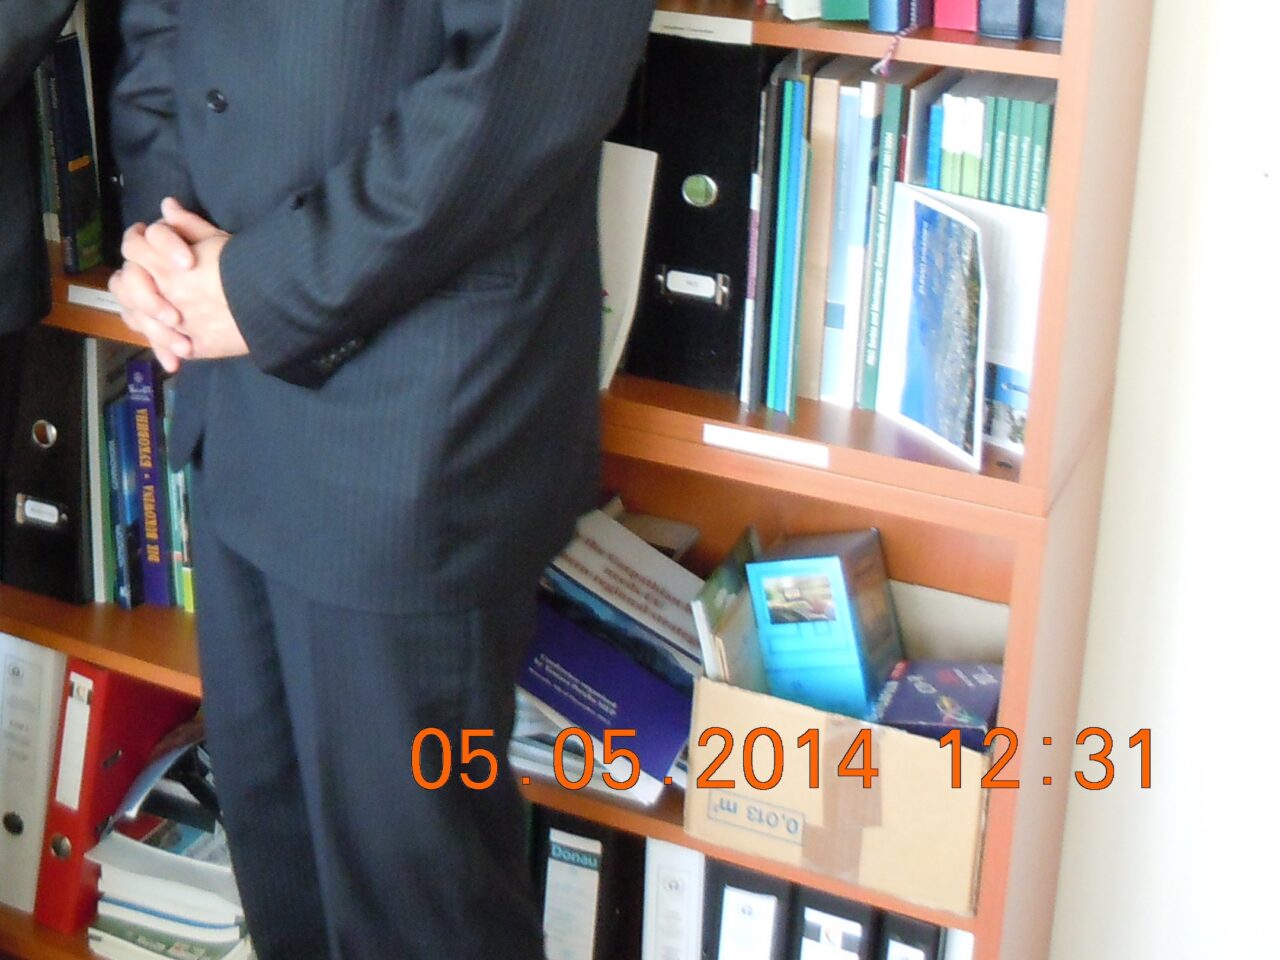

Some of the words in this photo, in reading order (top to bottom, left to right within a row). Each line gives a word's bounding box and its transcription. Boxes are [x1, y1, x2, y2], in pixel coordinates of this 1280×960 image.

[135, 408, 153, 468] БУКОВИНА
[142, 485, 158, 540] BUKOWINA
[146, 544, 160, 563] DIE
[746, 804, 800, 835] 0,013
[551, 843, 599, 869] Donau
